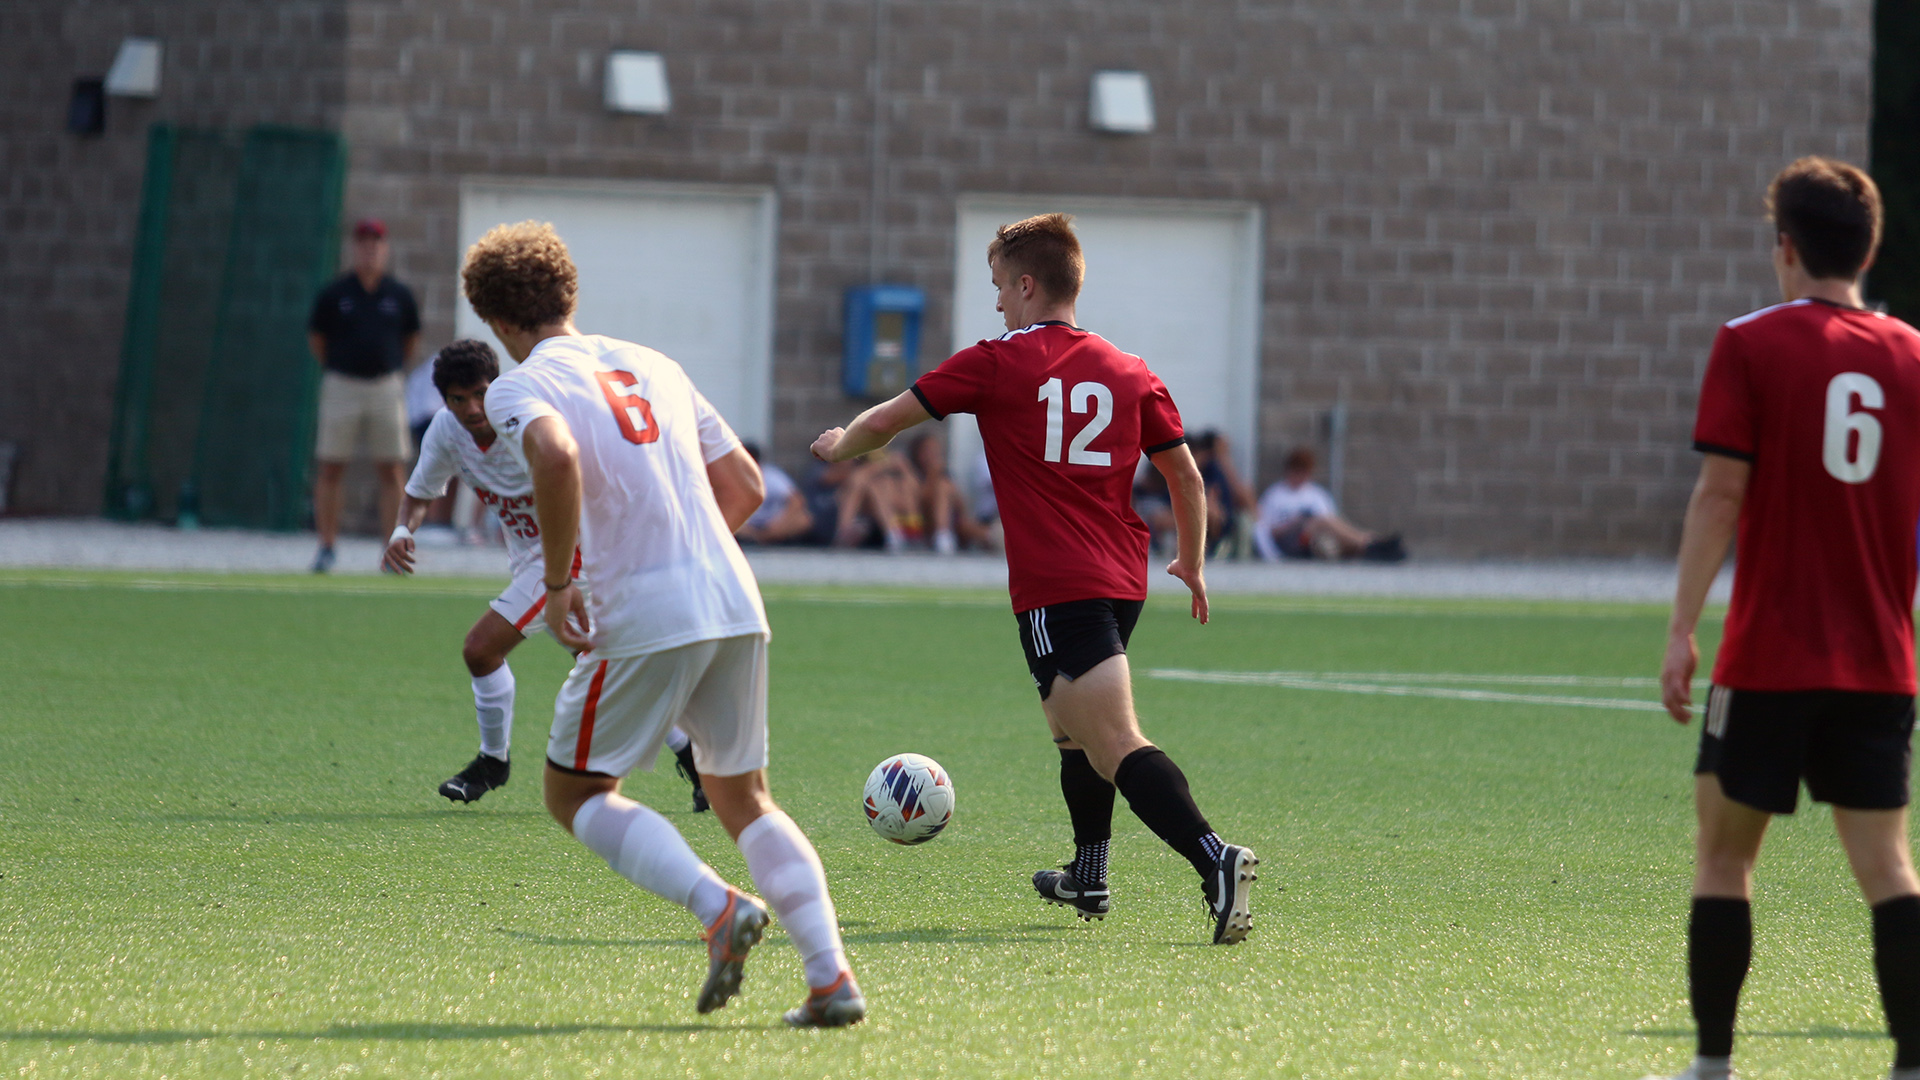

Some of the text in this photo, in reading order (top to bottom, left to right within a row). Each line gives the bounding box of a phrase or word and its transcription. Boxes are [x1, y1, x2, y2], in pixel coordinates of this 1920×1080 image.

[594, 369, 660, 445] 6
[1037, 376, 1114, 467] 12
[1822, 371, 1886, 485] 6
[499, 509, 539, 539] 23
